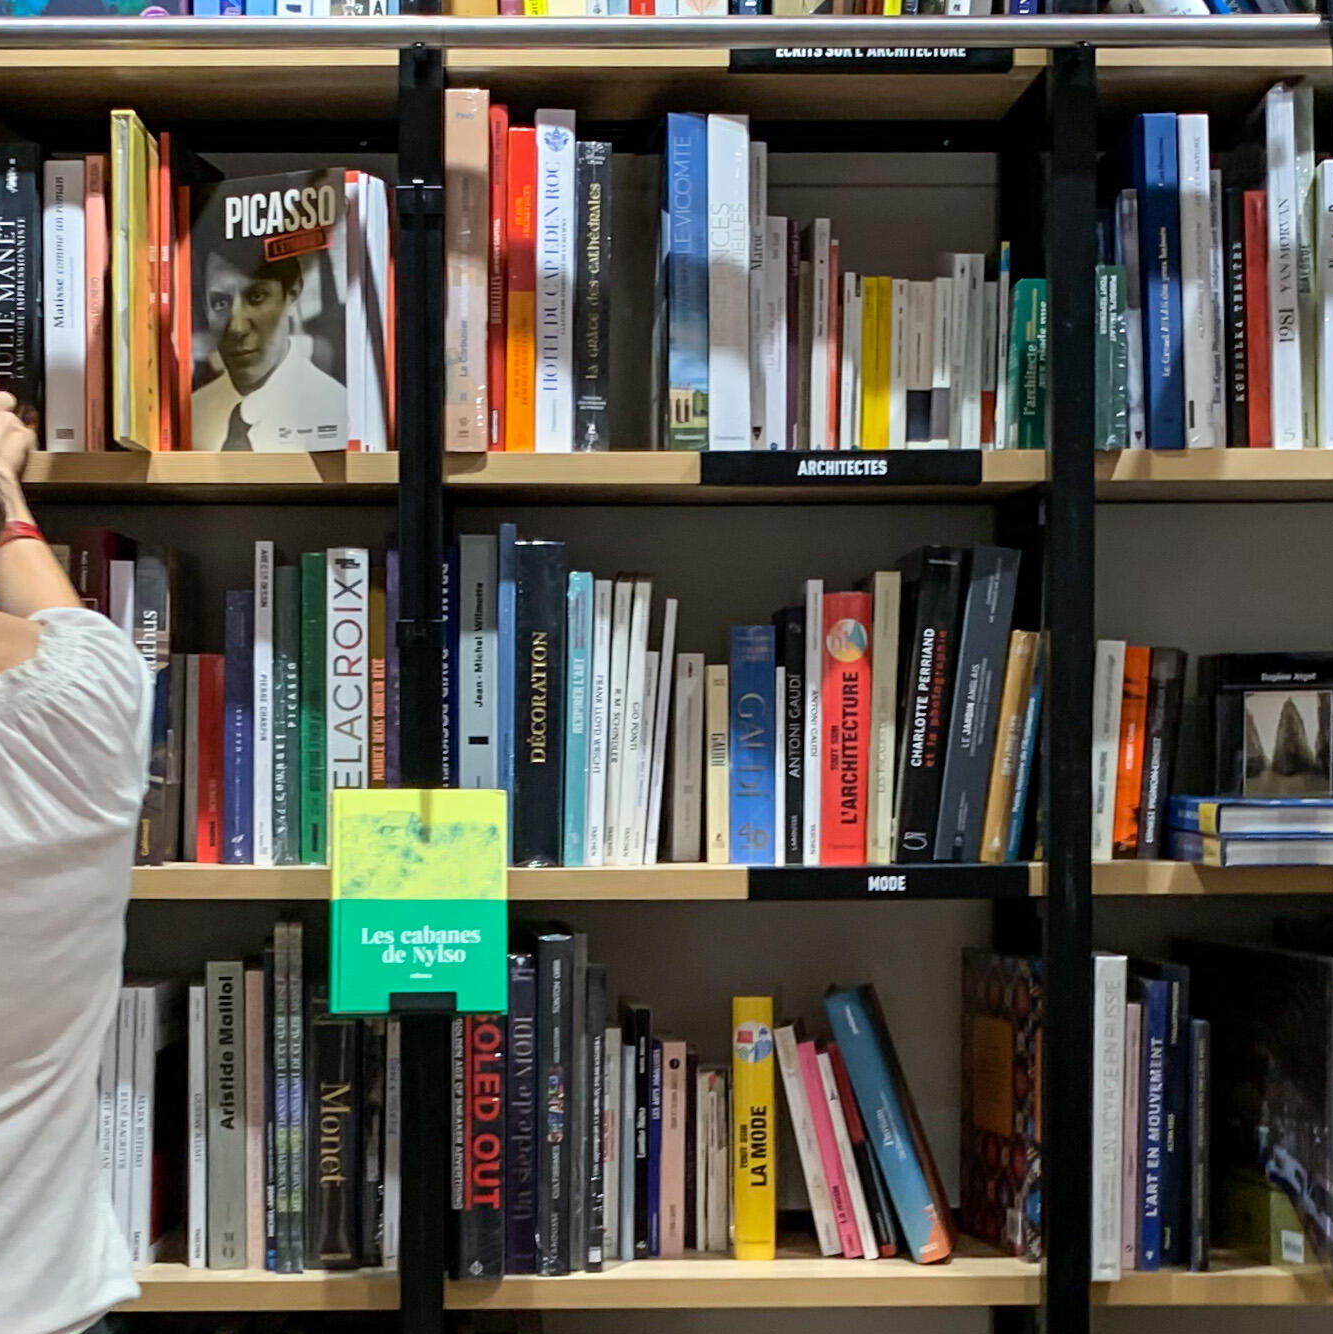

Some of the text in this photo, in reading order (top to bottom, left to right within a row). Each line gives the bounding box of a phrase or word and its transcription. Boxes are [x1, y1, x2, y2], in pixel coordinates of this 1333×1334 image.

[225, 185, 336, 239] PICASSO
[673, 135, 692, 226] VICOMTE
[53, 175, 65, 329] Matisse comme un roman
[543, 161, 561, 326] DU CAP EDEN ROC
[751, 232, 763, 271] Maroc
[1277, 197, 1295, 343] 1981 YAN MORVAN
[798, 460, 888, 476] ARCHITECTES
[474, 582, 483, 632] Wilmotte
[287, 661, 297, 729] PICASSO
[332, 579, 363, 789] ELACROIX
[527, 632, 548, 764] DÉCORATION
[572, 657, 585, 684] L'ART
[910, 628, 936, 767] CHARLOTTE PERRIAND
[572, 686, 585, 734] RESPIRER
[592, 674, 604, 774] FRANK LLOYD WRIGHT
[629, 702, 641, 751] GIO PONTI
[810, 690, 820, 726] ANTONI
[788, 722, 802, 778] ANTONI
[841, 671, 859, 825] L'ARCHITECTURE
[1145, 810, 1156, 844] ERNEST
[868, 876, 906, 891] MODE
[362, 925, 481, 945] Les cabanes
[382, 945, 466, 967] de Nylso
[218, 976, 236, 1130] Aristide Maillol
[134, 1094, 145, 1124] MARK
[319, 1081, 352, 1188] Monet
[1145, 1037, 1163, 1217] L'ART EN MOUVEMENT
[473, 1132, 502, 1209] OUT
[750, 1105, 767, 1187] LA MODE
